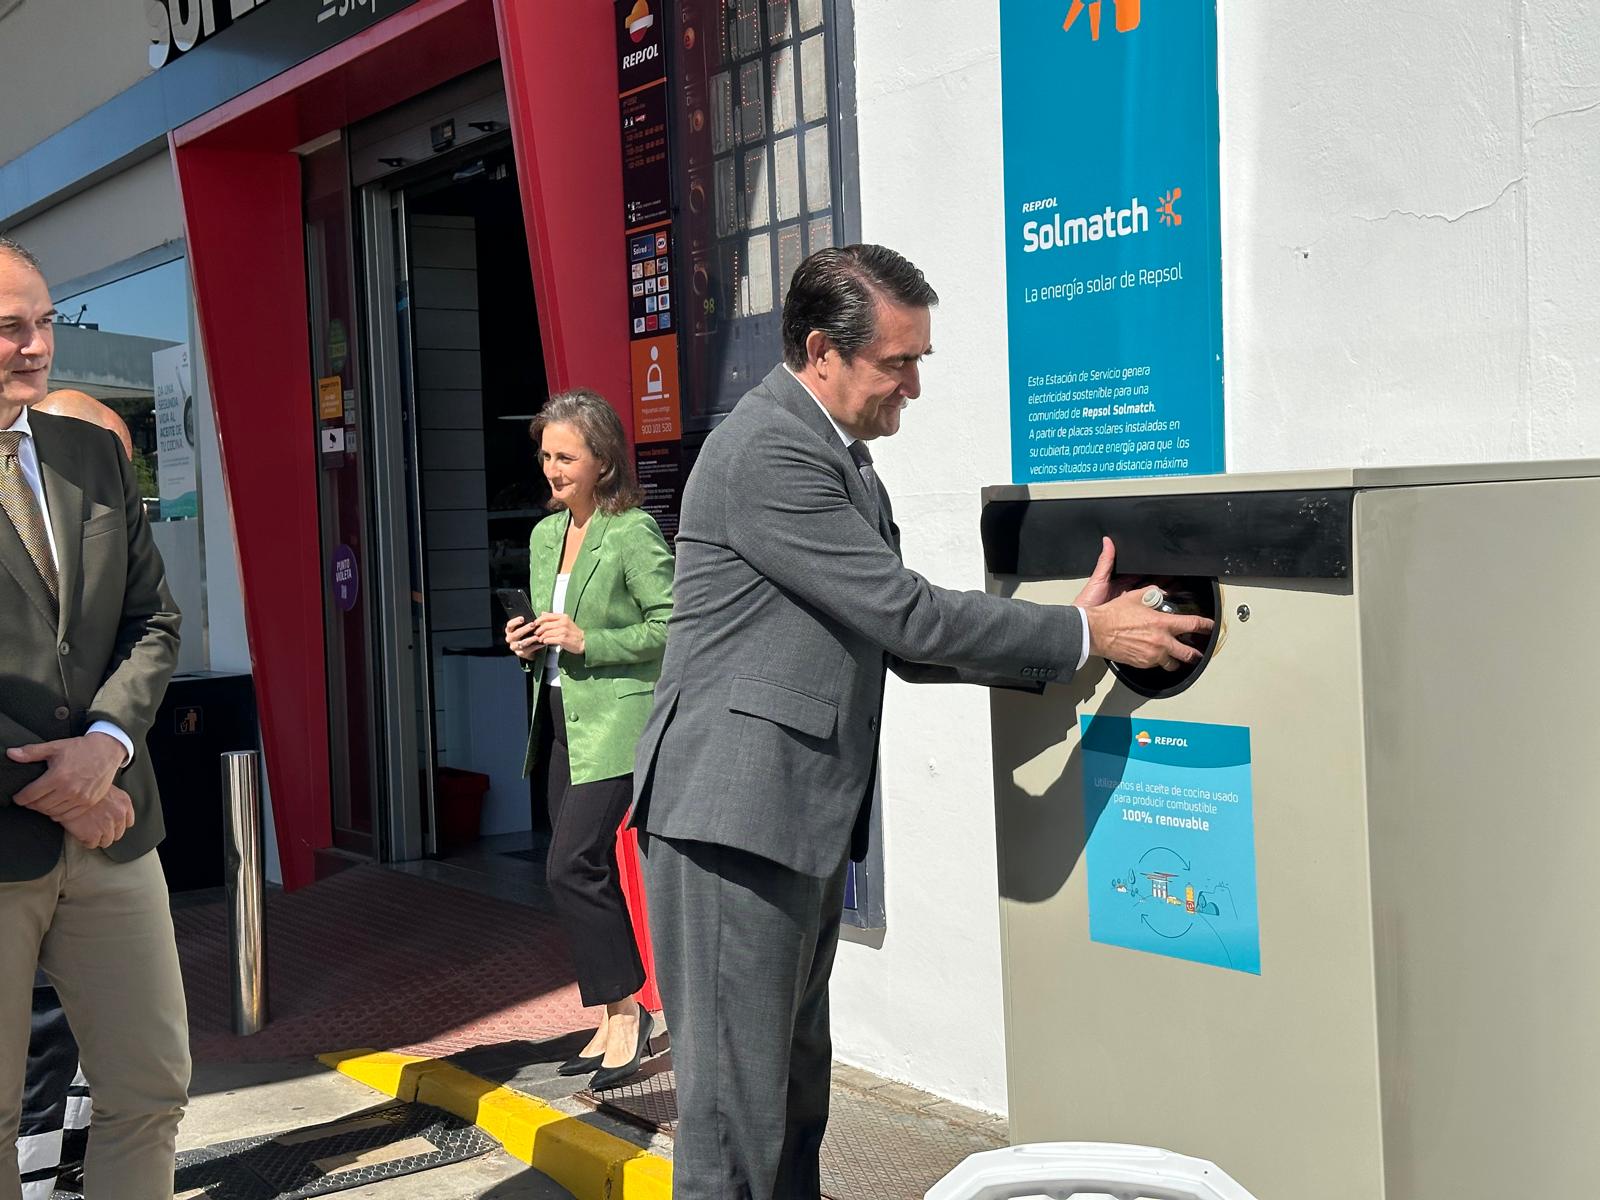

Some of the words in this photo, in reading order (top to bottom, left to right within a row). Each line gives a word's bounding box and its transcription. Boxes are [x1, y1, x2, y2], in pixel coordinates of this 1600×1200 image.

[622, 44, 658, 70] REPSOL
[1022, 197, 1058, 213] REPSOL
[1024, 198, 1148, 252] Solmatch
[1025, 287, 1038, 303] La
[1040, 278, 1084, 300] energía
[1086, 274, 1117, 294] solar
[1120, 270, 1135, 288] de
[1139, 262, 1183, 287] Repsol
[704, 298, 715, 314] 98
[1028, 376, 1044, 387] Esta
[1046, 370, 1077, 385] Estación
[1079, 370, 1088, 382] de
[1090, 368, 1120, 381] Servicio
[1122, 366, 1150, 381] genera
[1028, 390, 1071, 404] electricidad
[1072, 386, 1112, 401] sostenible
[1114, 386, 1132, 400] para
[1134, 385, 1149, 395] una
[1028, 408, 1070, 422] comunidad
[1071, 407, 1081, 418] de
[1082, 406, 1111, 420] Repsol
[1113, 402, 1156, 416] Solmatch.
[1029, 429, 1034, 439] A
[1036, 427, 1056, 441] partir
[1057, 427, 1067, 437] de
[1068, 425, 1094, 439] placas
[1095, 421, 1123, 435] solares
[1125, 420, 1168, 432] instaladas
[1169, 420, 1180, 430] en
[1029, 447, 1038, 457] su
[1040, 443, 1071, 457] cubierta,
[1072, 443, 1104, 457] produce
[1105, 439, 1134, 455] energía
[1136, 440, 1155, 452] para
[1156, 439, 1173, 452] que
[1176, 437, 1190, 449] los
[1029, 463, 1058, 475] vecinos
[1059, 461, 1091, 474] situados
[1092, 464, 1098, 472] a
[1099, 462, 1115, 471] una
[1116, 458, 1152, 471] distancia
[1154, 456, 1188, 470] máxima
[1154, 736, 1188, 747] REPSOL
[1094, 777, 1134, 791] Utilizamos
[1136, 782, 1143, 792] el
[1145, 784, 1169, 795] aceite
[1172, 785, 1182, 796] de
[1183, 787, 1210, 800] cocina
[1213, 791, 1238, 803] usado
[1114, 795, 1131, 804] para
[1132, 795, 1165, 807] producir
[1166, 798, 1217, 815] combustible
[1122, 809, 1152, 824] 100%
[1155, 814, 1209, 831] renovable
